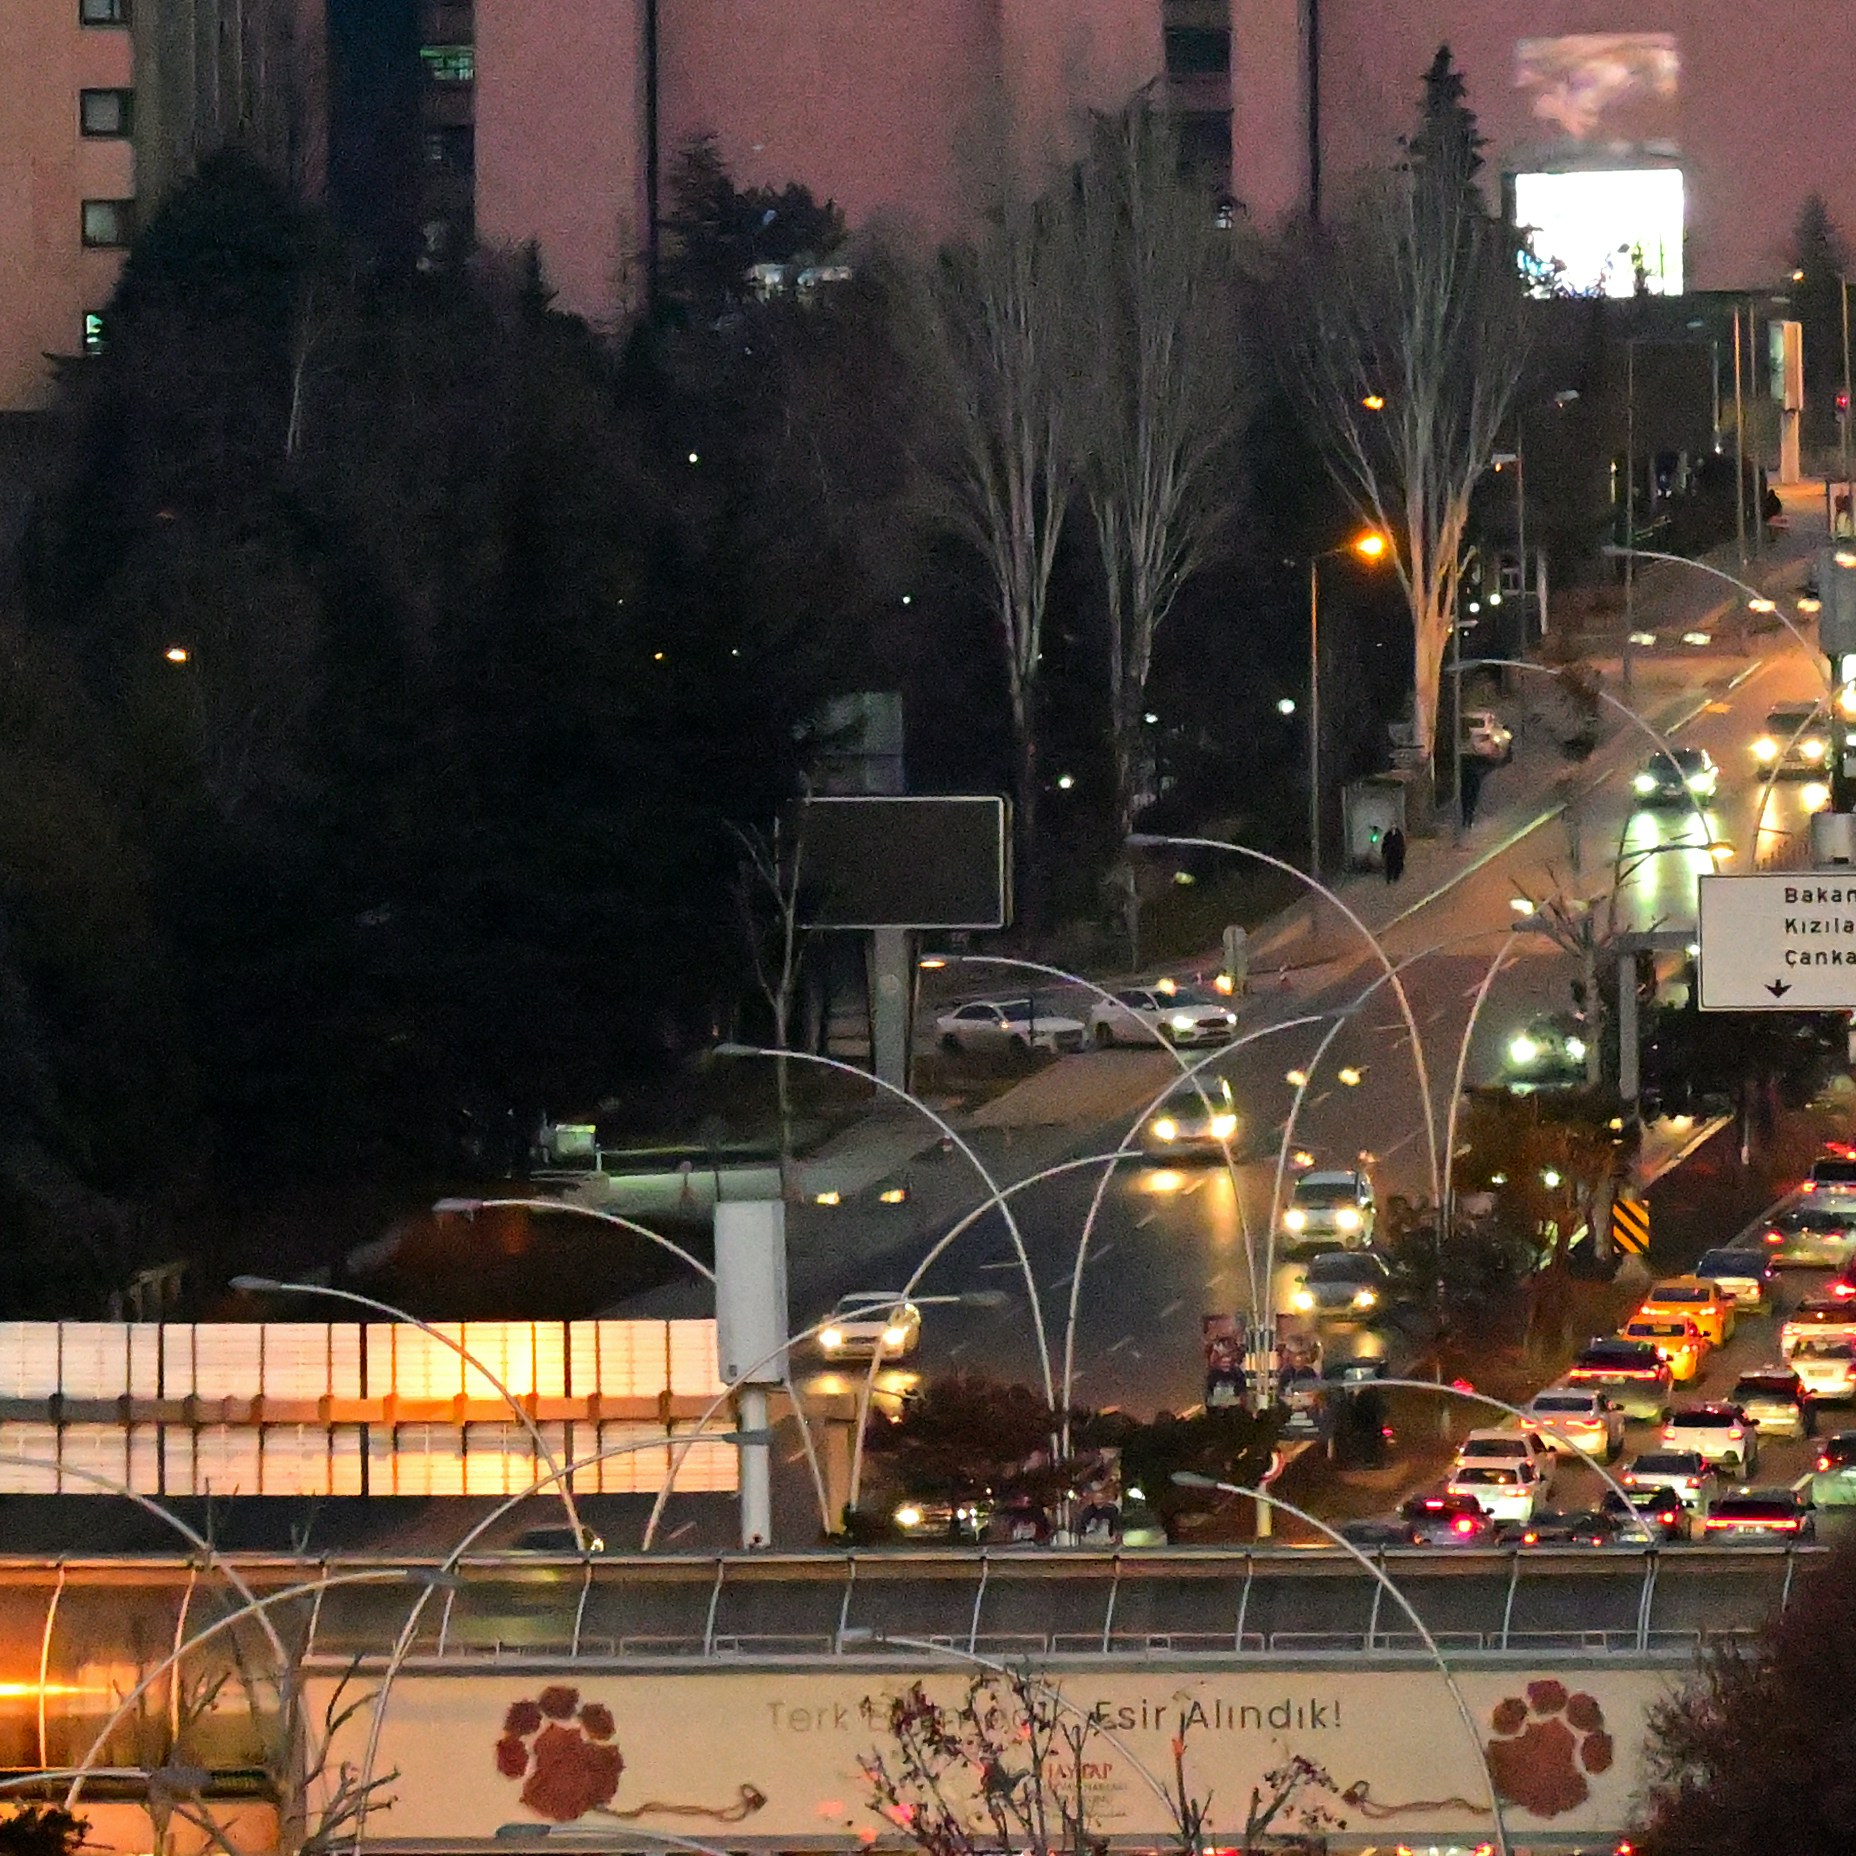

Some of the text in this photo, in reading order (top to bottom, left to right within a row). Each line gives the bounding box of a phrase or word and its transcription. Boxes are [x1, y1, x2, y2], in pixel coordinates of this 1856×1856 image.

[766, 1700, 849, 1732] Terk
[1094, 1698, 1167, 1731] Esir
[1186, 1698, 1342, 1730] Alındık!
